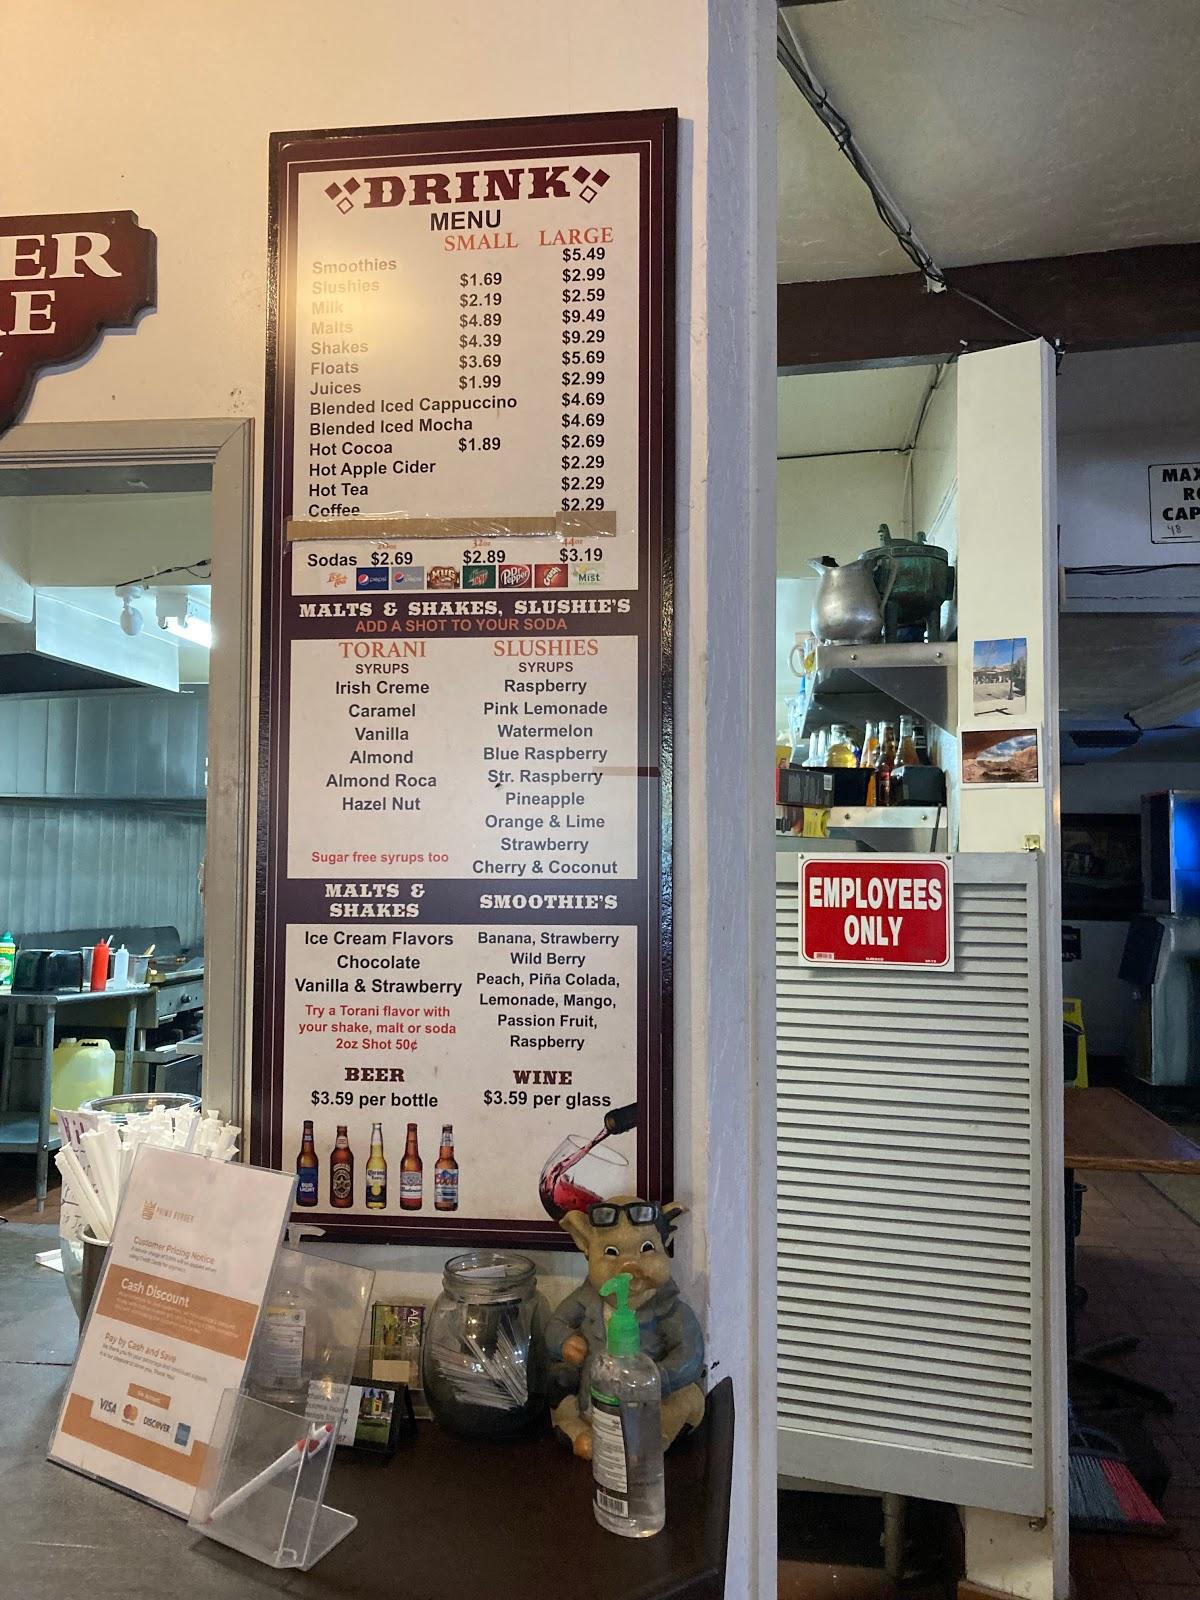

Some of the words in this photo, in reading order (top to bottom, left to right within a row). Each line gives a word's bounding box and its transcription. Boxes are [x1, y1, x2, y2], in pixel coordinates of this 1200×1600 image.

[364, 166, 570, 208] DRINK
[431, 210, 501, 231] MENU
[444, 232, 518, 251] SMALL
[539, 227, 613, 246] LARGE
[562, 248, 605, 262] $5.49
[312, 258, 396, 274] Smoothies
[460, 272, 502, 288] $1.69
[562, 268, 605, 283] $2.99
[460, 293, 502, 308] $2.19
[562, 289, 605, 303] $2.59
[460, 314, 501, 329] $4.89
[562, 309, 605, 324] $9.49
[459, 334, 501, 349] $4.39
[562, 330, 605, 345] $9.29
[311, 341, 368, 355] Shakes
[311, 361, 358, 375] Floats
[459, 355, 501, 370] $3.69
[562, 351, 604, 366] $5.69
[310, 381, 361, 395] Juices
[459, 376, 501, 390] $1.99
[562, 372, 604, 387] $2.99
[310, 401, 375, 416] Blended
[381, 400, 413, 413] Iced
[419, 396, 517, 412] Cappuccino
[562, 392, 604, 407] $4.69
[310, 421, 375, 436] Blended
[381, 420, 413, 433] Iced
[419, 418, 473, 432] Mocha
[562, 413, 604, 428] $4.69
[310, 442, 337, 456] Hot
[342, 441, 392, 455] Cocoa
[458, 437, 500, 452] $1.89
[562, 434, 604, 450] $2.69
[309, 463, 336, 477] Hot
[341, 462, 386, 476] Apple
[392, 460, 436, 474] Cider
[562, 455, 604, 470] $2.29
[309, 484, 336, 497] Hot
[341, 483, 368, 496] Tea
[562, 476, 604, 492] $2.29
[308, 553, 357, 568] Sodas
[371, 552, 413, 567] $2.69
[463, 550, 505, 565] $2.89
[560, 548, 603, 563] $3.19
[432, 569, 456, 580] MUG
[504, 571, 528, 585] Pepper
[544, 567, 561, 585] Crush
[579, 574, 600, 582] Mist
[300, 602, 372, 618] MALTS
[355, 620, 385, 632] ADD
[390, 620, 402, 631] A
[406, 620, 446, 632] SHOT
[450, 620, 472, 631] TO
[475, 619, 519, 631] YOUR
[523, 618, 567, 630] SODA
[339, 641, 427, 658] TORANI
[494, 639, 598, 657] SLUSHIES
[355, 663, 409, 674] SYRUPS
[519, 661, 573, 673] SYRUPS
[336, 681, 370, 695] Irish
[376, 681, 430, 694] Creme
[504, 679, 587, 695] Raspberry
[349, 704, 415, 718] Caramel
[484, 702, 519, 715] Pink
[524, 702, 607, 715] Lemonade
[354, 727, 409, 741] Vanilla
[498, 724, 593, 738] Watermelon
[350, 750, 413, 764] Almond
[484, 747, 519, 761] Blue
[524, 747, 607, 764] Raspberry
[327, 774, 390, 788] Almond
[395, 774, 437, 788] Roca
[488, 769, 514, 784] Str.
[520, 770, 602, 786] Raspberry
[342, 797, 387, 811] Hazel
[391, 797, 420, 811] Nut
[506, 792, 584, 808] Pineapple
[485, 814, 544, 830] Orange
[549, 815, 561, 828] &
[566, 815, 604, 828] Lime
[501, 837, 588, 853] Strawberry
[312, 851, 348, 864] Sugar
[352, 850, 377, 862] free
[381, 852, 424, 864] syrups
[428, 852, 448, 862] too
[473, 860, 526, 876] Cherry
[532, 860, 544, 874] &
[549, 860, 617, 874] Coconut
[325, 884, 399, 897] MALTS
[810, 877, 942, 911] EMPLOYEES
[330, 903, 419, 917] SHAKES
[305, 932, 328, 945] Ice
[334, 932, 386, 945] Cream
[392, 931, 453, 946] Flavors
[844, 915, 903, 946] ONLY
[478, 932, 535, 946] Banana,
[541, 932, 619, 947] Strawberry
[337, 955, 420, 969] Chocolate
[511, 953, 542, 965] Wild
[547, 953, 585, 967] Berry
[295, 978, 349, 993] Vanilla
[355, 980, 367, 993] &
[372, 979, 462, 996] Strawberry
[477, 973, 523, 987] Peach,
[565, 974, 620, 988] Colada,
[480, 993, 558, 1008] Lemonade,
[563, 995, 616, 1009] Mango,
[306, 1005, 324, 1017] Try
[329, 1008, 335, 1016] a
[340, 1005, 379, 1016] Torani
[383, 1005, 419, 1017] flavor
[423, 1005, 450, 1017] with
[299, 1024, 328, 1034] your
[331, 1022, 372, 1034] shake,
[376, 1022, 404, 1033] malt
[408, 1025, 420, 1034] or
[425, 1023, 456, 1034] soda
[498, 1014, 555, 1028] Passion
[560, 1015, 597, 1029] Fruit,
[336, 1039, 358, 1049] 2oz
[362, 1038, 392, 1050] Shot
[510, 1035, 584, 1051] Raspberry
[345, 1068, 404, 1082] BEER
[513, 1070, 572, 1085] WINE
[311, 1091, 354, 1106] $3.59
[359, 1095, 386, 1109] per
[391, 1093, 438, 1107] bottle
[484, 1090, 527, 1106] $3.59
[533, 1094, 561, 1109] per
[566, 1092, 611, 1110] glass
[134, 1236, 165, 1250] Customer
[166, 1245, 190, 1260] Pricing
[191, 1252, 215, 1264] Notice
[121, 1278, 144, 1295] Cash
[146, 1285, 190, 1307] Discount
[105, 1332, 117, 1345] Pay
[119, 1336, 126, 1348] by
[128, 1340, 144, 1352] Cash
[146, 1345, 159, 1357] and
[160, 1350, 176, 1363] Save
[100, 1398, 117, 1414] VISA
[143, 1417, 170, 1432] DISCOVER
